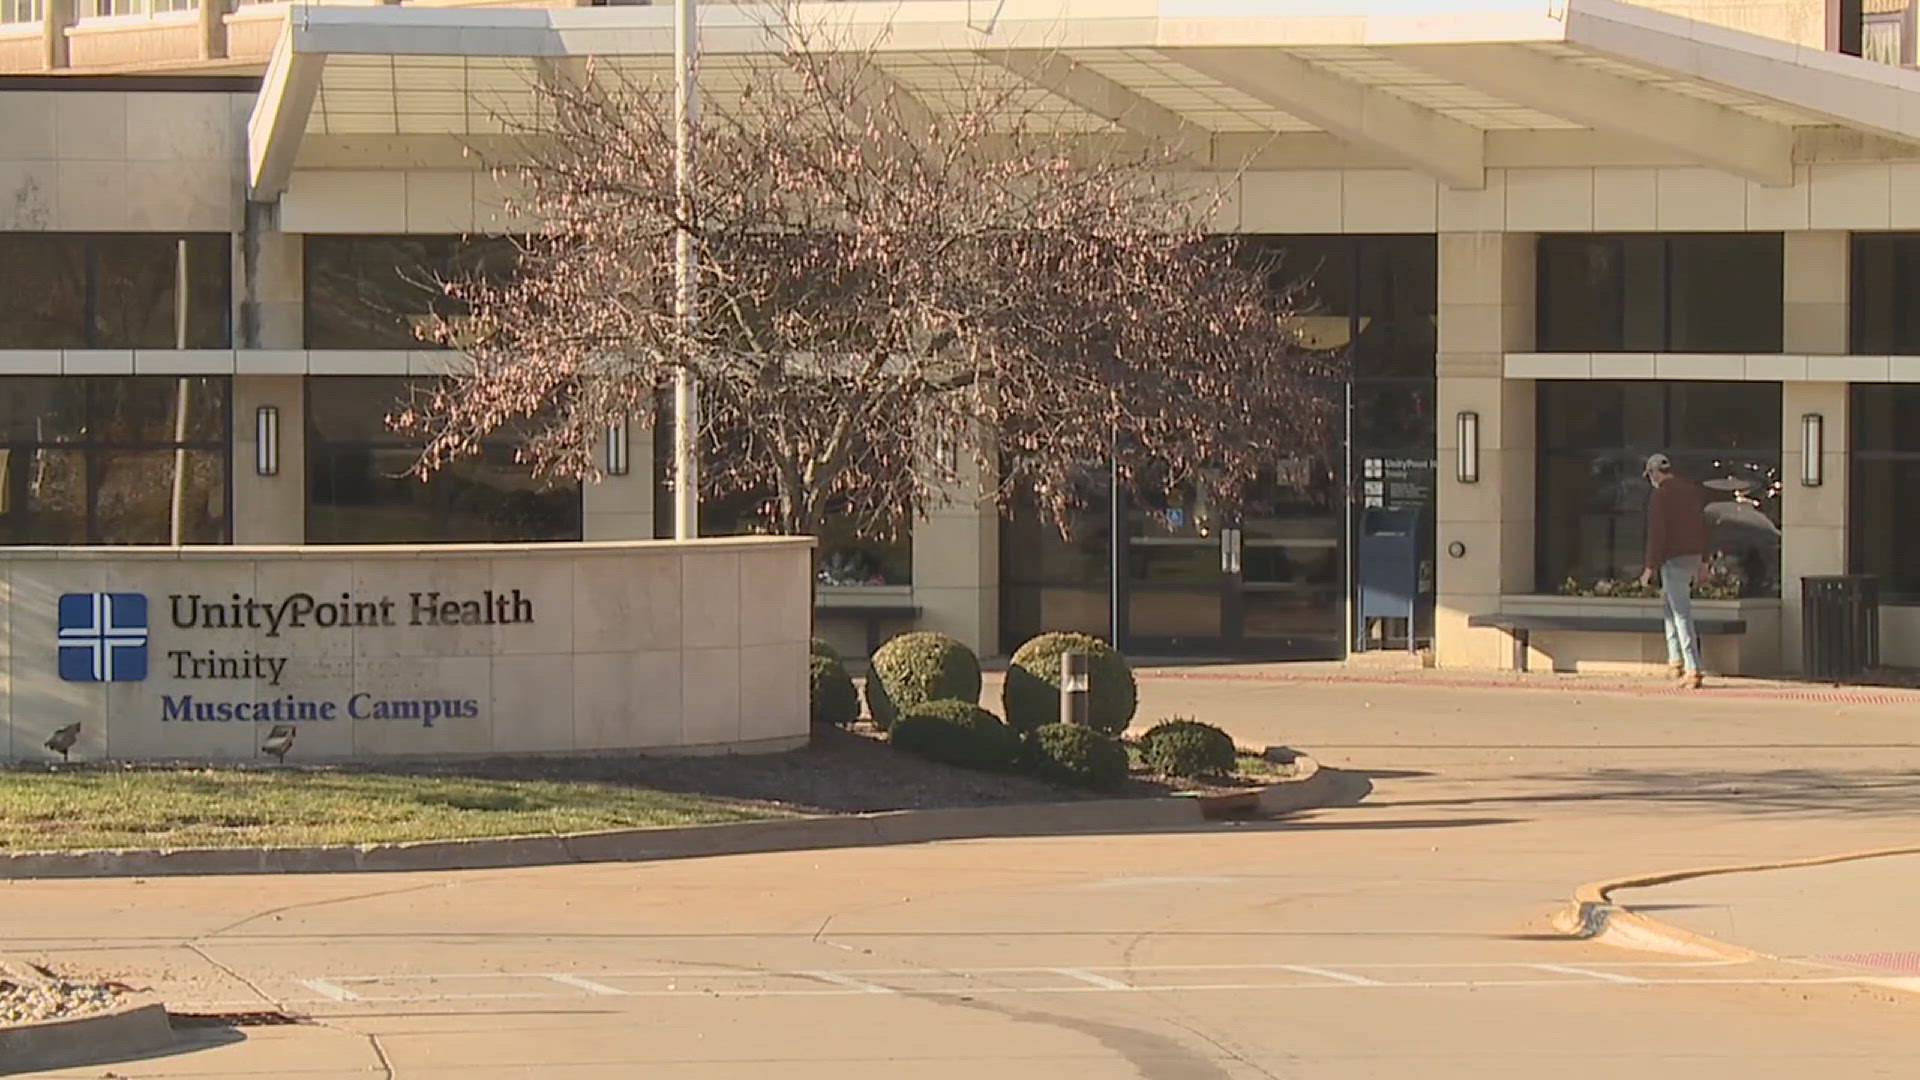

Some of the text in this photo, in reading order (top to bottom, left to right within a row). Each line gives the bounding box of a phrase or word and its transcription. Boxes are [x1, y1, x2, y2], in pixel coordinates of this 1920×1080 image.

[169, 590, 535, 637] UnityPoint Health
[168, 650, 287, 685] Trinity
[161, 693, 479, 727] Muscatine Campus
